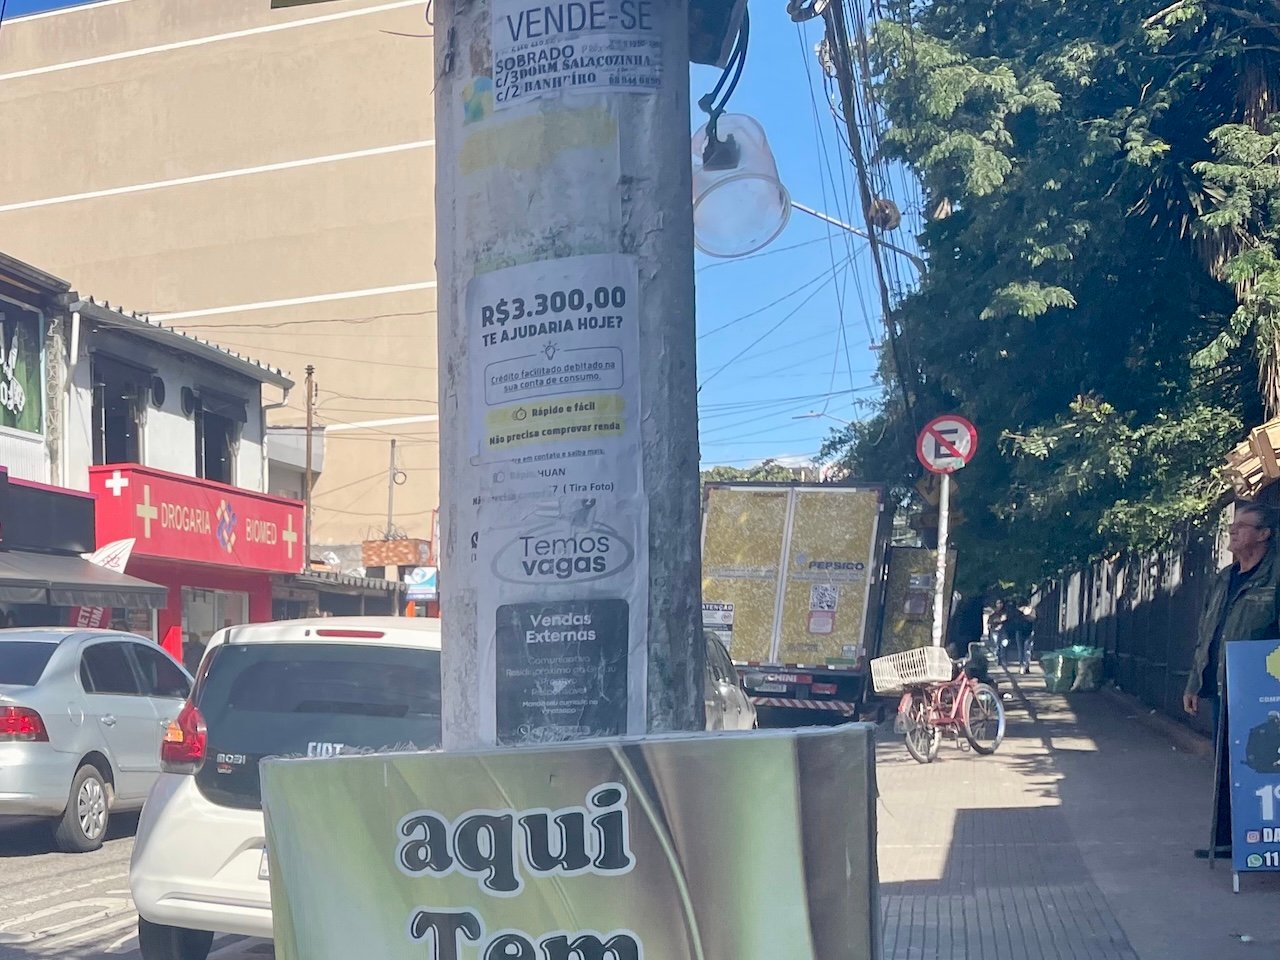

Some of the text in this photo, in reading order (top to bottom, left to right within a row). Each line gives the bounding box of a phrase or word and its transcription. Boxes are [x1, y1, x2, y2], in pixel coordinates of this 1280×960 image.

[506, 0, 654, 42] VENDE-SE
[495, 44, 575, 75] SOBRADO
[481, 286, 626, 328] R$3.300,00
[482, 316, 623, 347] TE AJUDARIA HOJE?
[521, 366, 562, 379] facilitado
[564, 361, 603, 372] debitado
[605, 361, 616, 369] na
[504, 384, 518, 393] sua
[520, 378, 544, 389] conta
[546, 376, 557, 385] de
[532, 405, 564, 417] Rápido
[574, 402, 596, 412] fácil
[489, 422, 620, 446] Não precisa comprovar renda
[569, 483, 587, 492] Tira
[161, 502, 211, 535] DROGARIA
[246, 518, 277, 545] BIOMED
[520, 535, 610, 558] Temos
[522, 555, 607, 579] vagas
[808, 560, 865, 571] PEPSICO
[530, 612, 592, 627] Vendas
[525, 629, 596, 644] Externas
[765, 671, 798, 684] CHINI
[307, 741, 345, 757] FIAT
[399, 785, 632, 893] aqui
